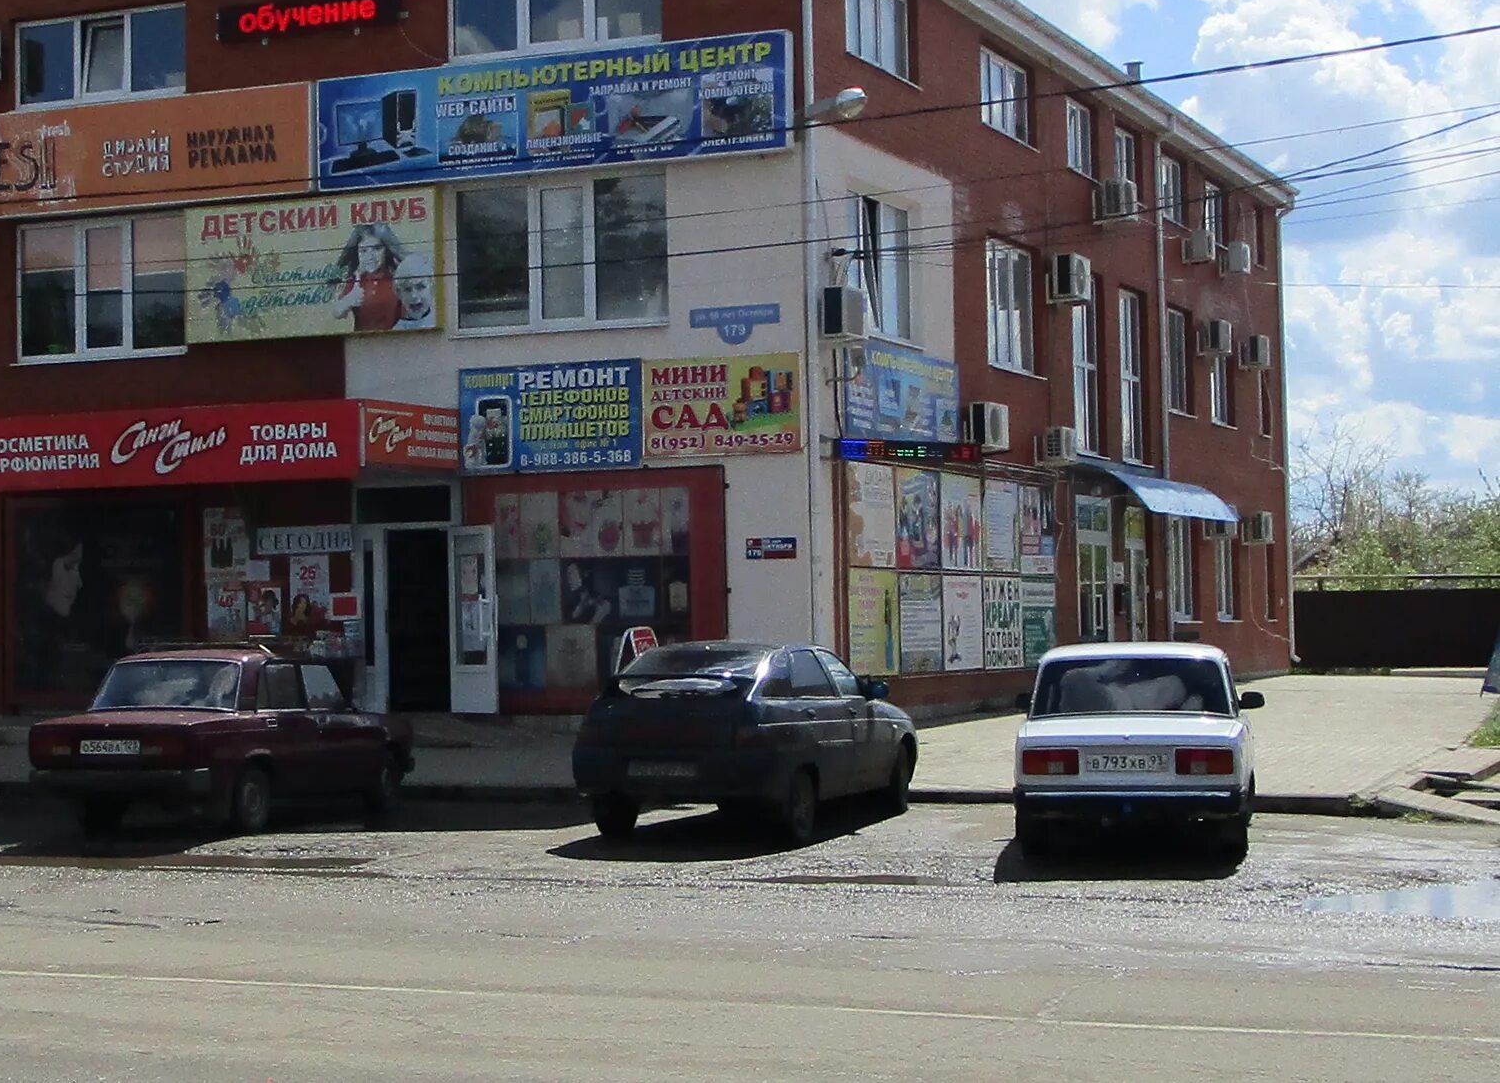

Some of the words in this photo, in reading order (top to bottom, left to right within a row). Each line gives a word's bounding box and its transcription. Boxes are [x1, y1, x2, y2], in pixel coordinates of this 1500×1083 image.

[437, 48, 671, 96] КОМПЬЮТЕРНЫЙ
[679, 42, 772, 73] ЦЕНТР
[714, 69, 756, 81] РЕМОНТ
[588, 82, 640, 96] ЗАПРАВКА
[651, 77, 693, 90] РЕМОНТ
[699, 81, 774, 100] КОМПЬЮТЕРОВ
[436, 102, 465, 118] WEB
[102, 130, 170, 158] ДИЗАЙН
[186, 124, 275, 148] НАРУЖНАЯ
[526, 132, 603, 149] ЛИЦЕНЗИОННЫЕ
[188, 145, 277, 168] РЕКЛАМА
[448, 141, 498, 156] СОЗДАНИЕ
[102, 155, 170, 178] СТУДИЯ
[201, 201, 339, 242] ДЕТСКИЙ
[350, 197, 428, 226] КЛУБ
[723, 324, 746, 336] 179
[519, 367, 631, 391] РЕМОНТ
[651, 364, 728, 386] МИНИ
[520, 387, 630, 407] ТЕЛЕФОНОВ
[520, 403, 630, 424] СМАРТФОНОВ
[651, 402, 730, 431] САД
[250, 422, 327, 441] ТОВАРЫ
[520, 420, 630, 442] ПЛАНШЕТОВ
[651, 433, 705, 449] 8(952)
[714, 432, 794, 447] 849-25-29
[111, 420, 183, 465] Санги
[155, 427, 227, 474] Стиль
[239, 443, 278, 465] ДЛЯ
[281, 442, 338, 463] ДОМА
[258, 530, 352, 551] СЕГОДНЯ
[984, 579, 1020, 601] НУЖЕН
[985, 602, 1021, 629] КРЕДИТ
[986, 631, 1021, 649] ГОТОВЫ
